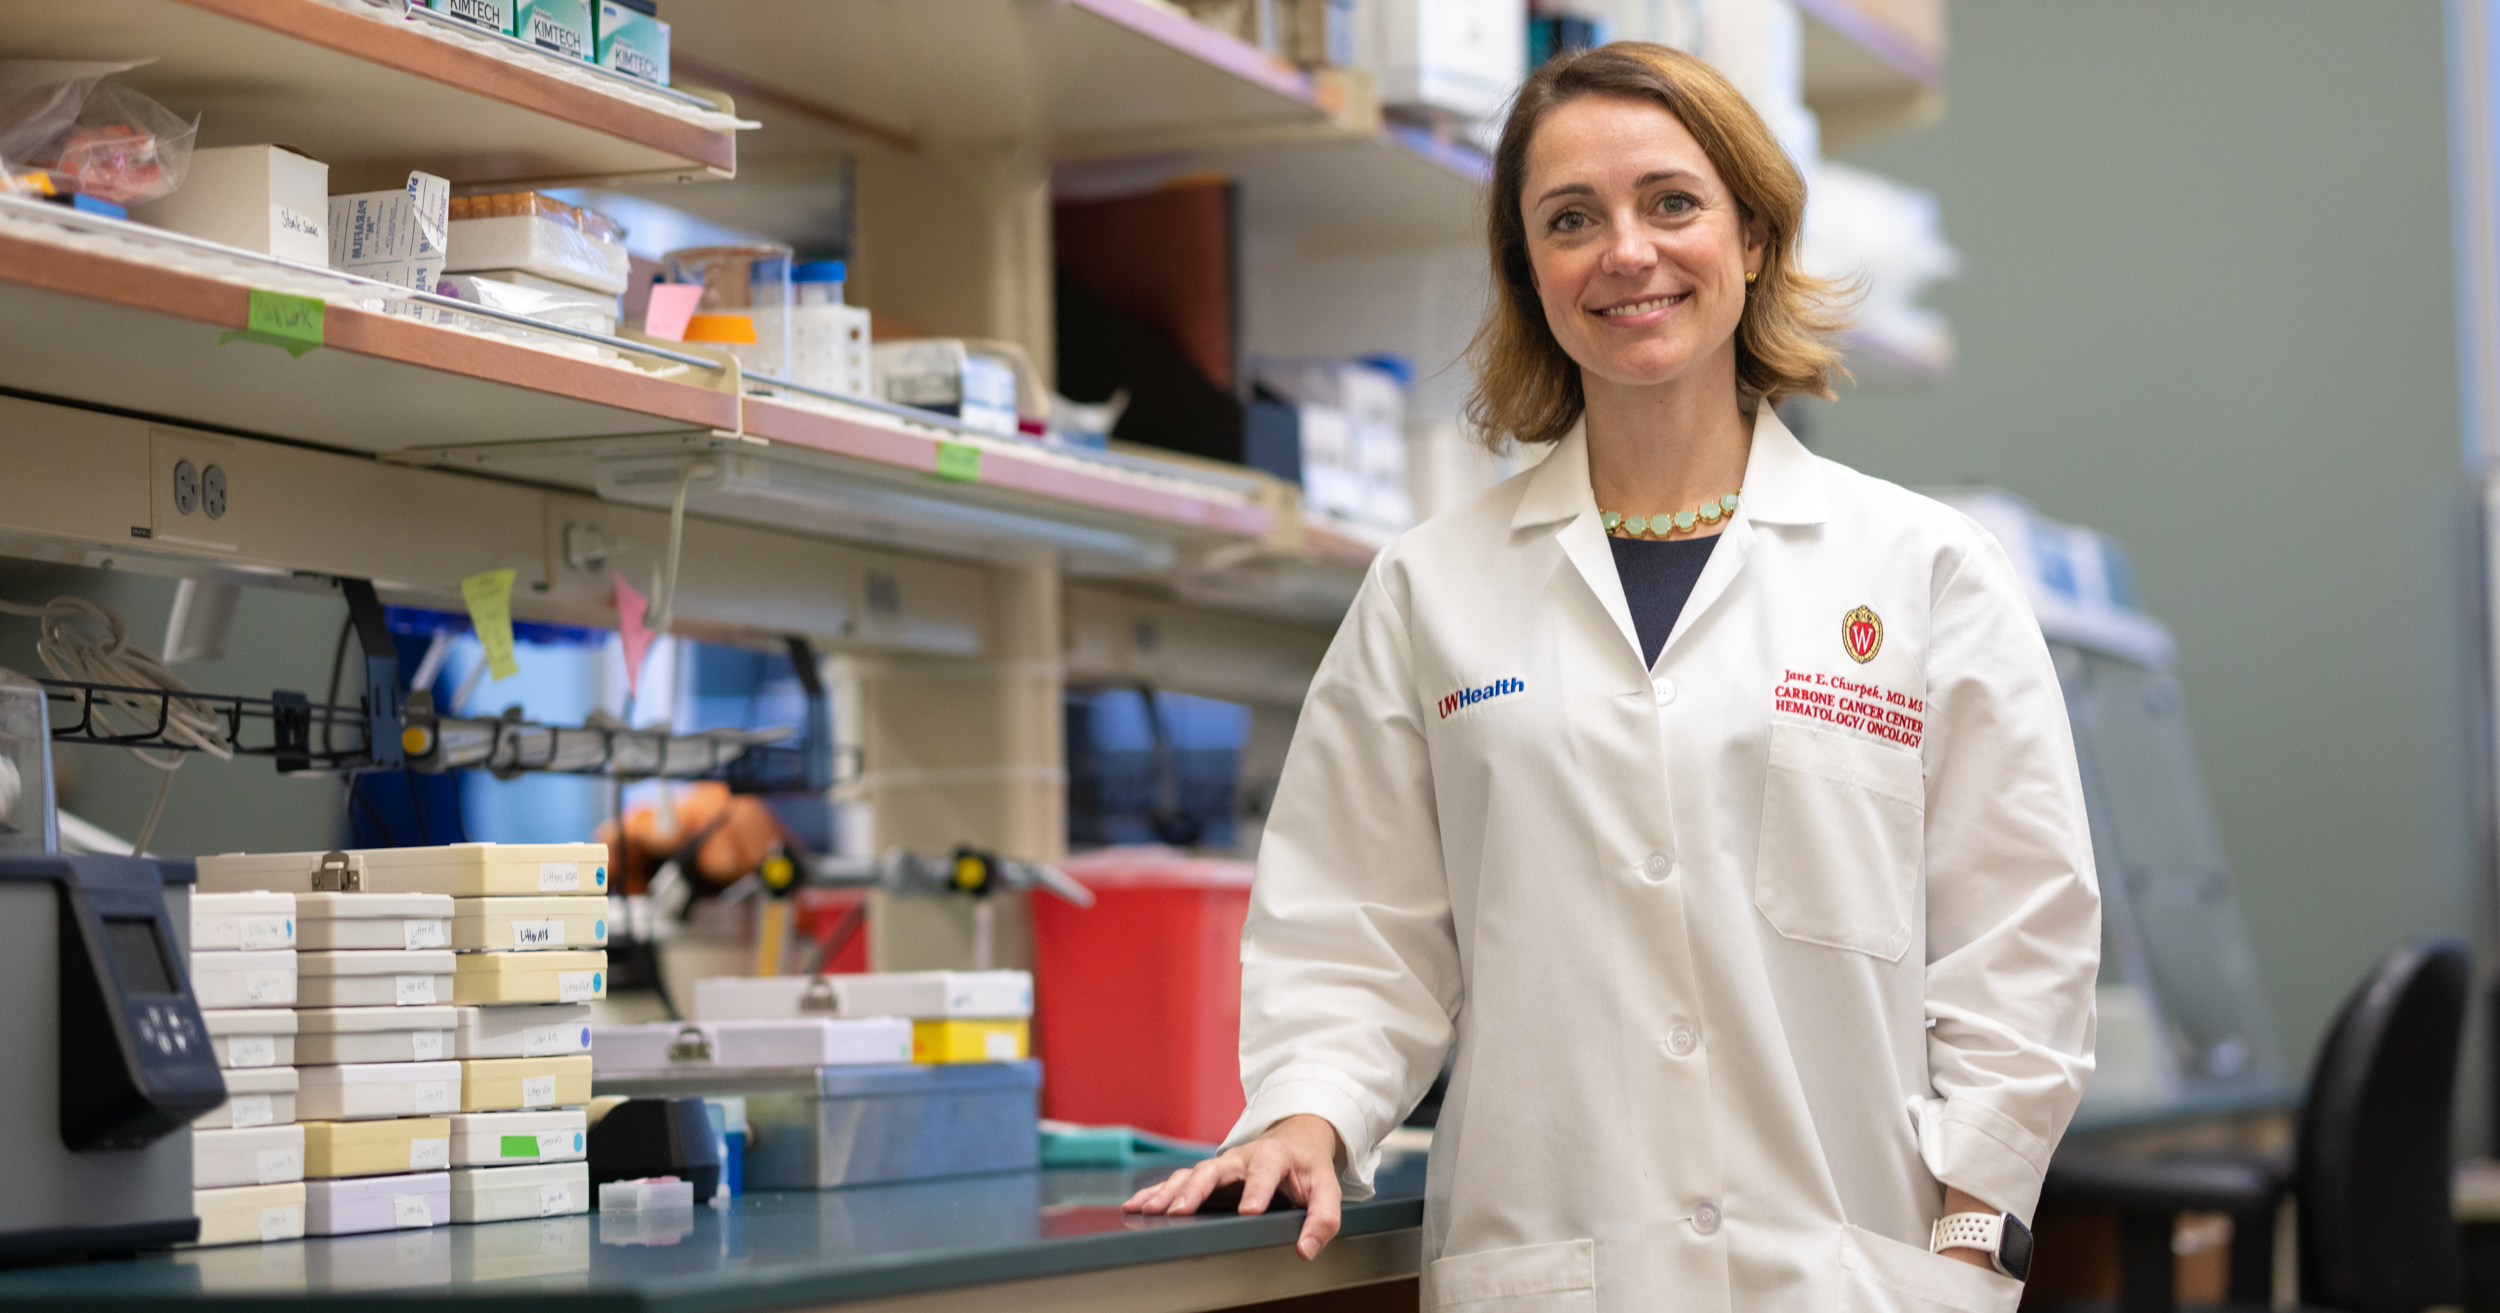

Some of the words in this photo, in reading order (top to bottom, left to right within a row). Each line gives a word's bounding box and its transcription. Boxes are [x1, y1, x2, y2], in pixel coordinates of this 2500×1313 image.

[534, 18, 581, 50] KIMTECH
[615, 47, 658, 79] KIMTECH
[1852, 625, 1874, 653] W
[1775, 686, 1836, 707] CARBONE
[1839, 698, 1884, 720] CANCER
[1886, 711, 1924, 734] CENTER
[1783, 669, 1812, 683] Jane
[1815, 673, 1828, 686] E.
[1830, 676, 1883, 700] Churpek,
[1886, 690, 1906, 708] MD,
[1908, 697, 1923, 713] MS
[1775, 699, 1865, 731] HEMATOLOGY/
[1867, 721, 1922, 748] ONCOLOGY
